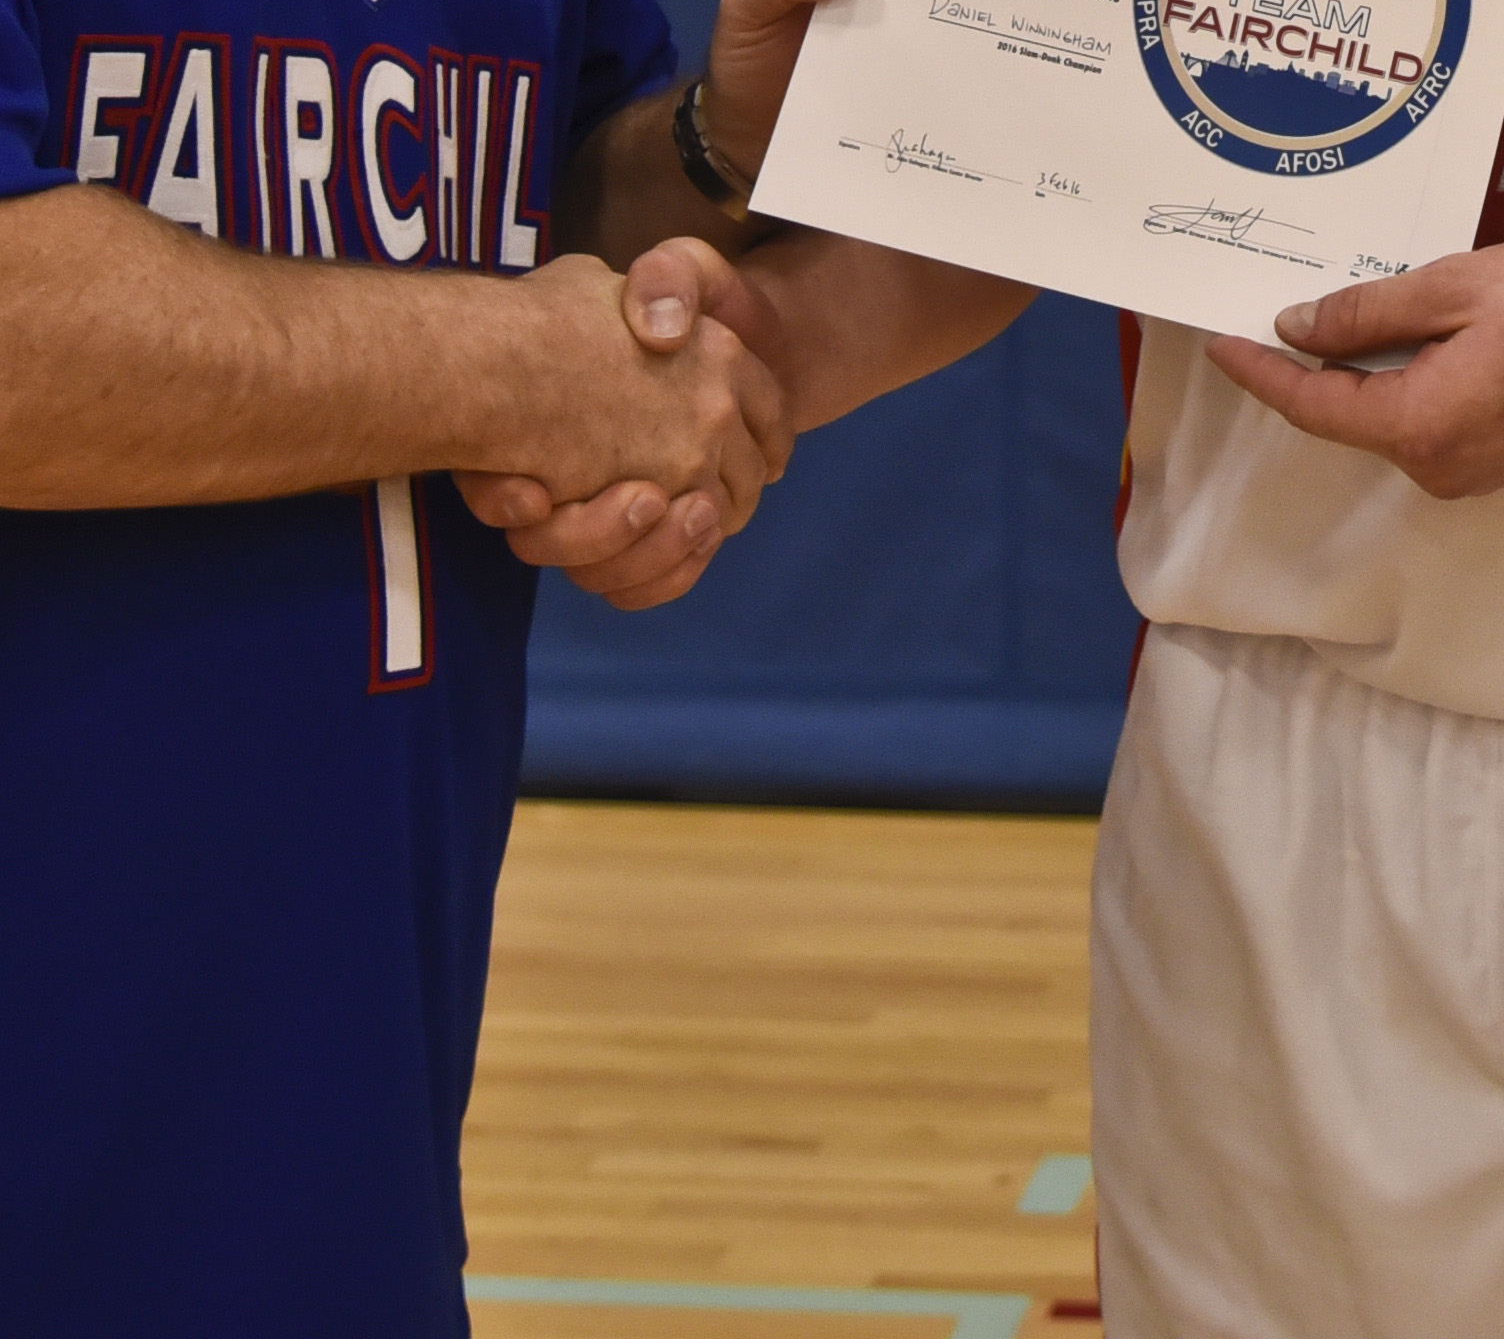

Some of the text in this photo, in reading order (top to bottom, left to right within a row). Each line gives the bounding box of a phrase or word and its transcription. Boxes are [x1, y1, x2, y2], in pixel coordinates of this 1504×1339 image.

[1405, 62, 1451, 123] AFRC
[1181, 109, 1224, 149] ACC
[1275, 147, 1345, 173] AFOSI
